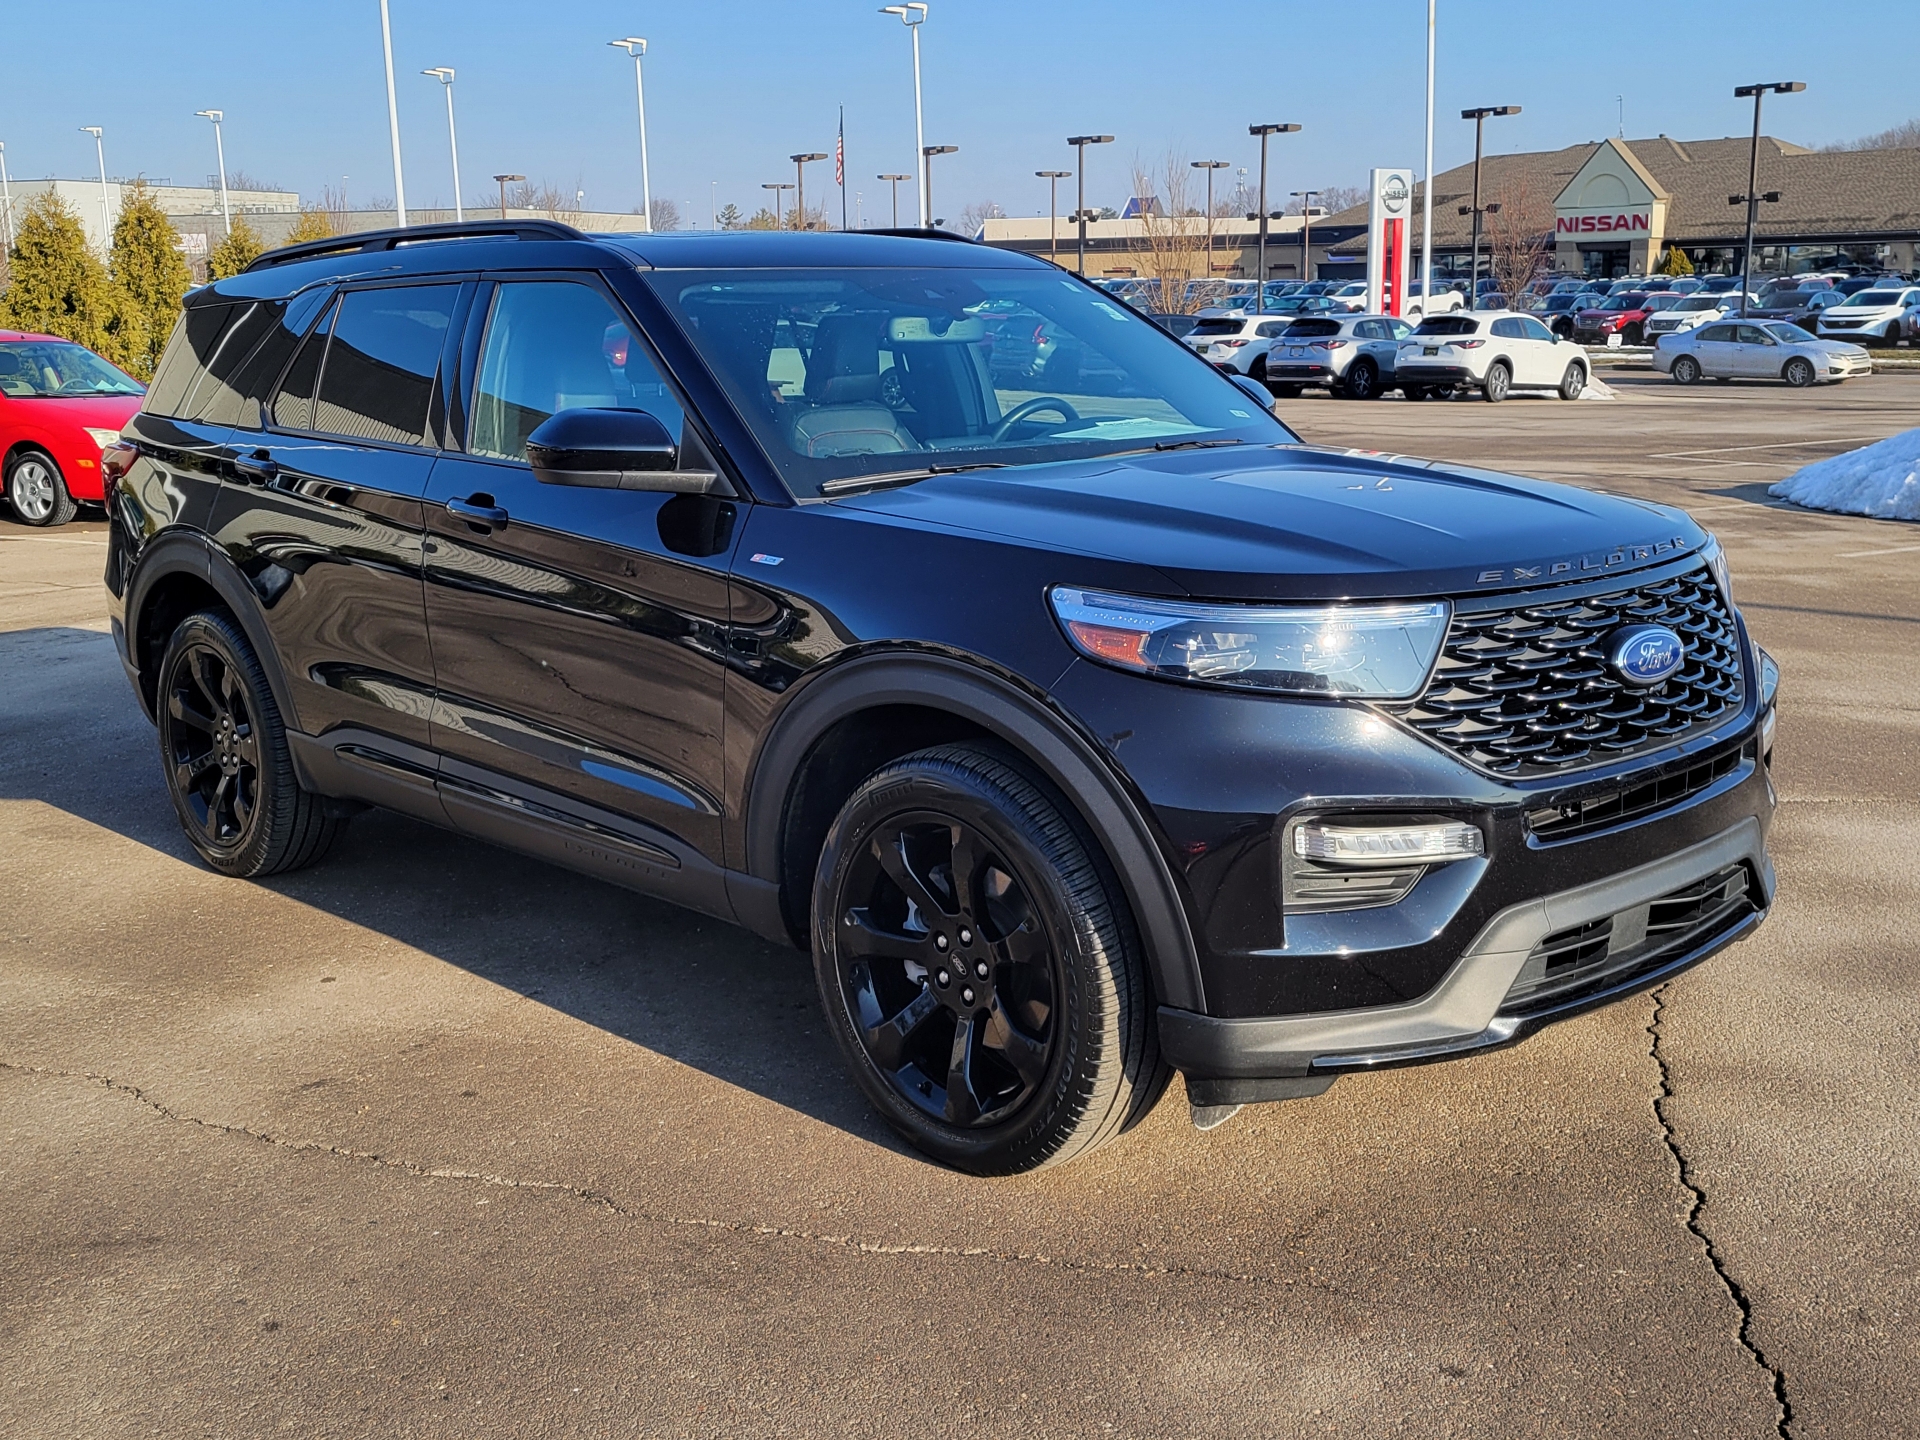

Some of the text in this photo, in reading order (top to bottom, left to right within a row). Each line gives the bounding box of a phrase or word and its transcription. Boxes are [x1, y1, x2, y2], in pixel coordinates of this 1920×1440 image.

[1557, 213, 1649, 233] NISSAN
[1476, 535, 1685, 584] EXPLORER
[1638, 639, 1674, 672] Ford
[868, 776, 913, 806] PIRELLI
